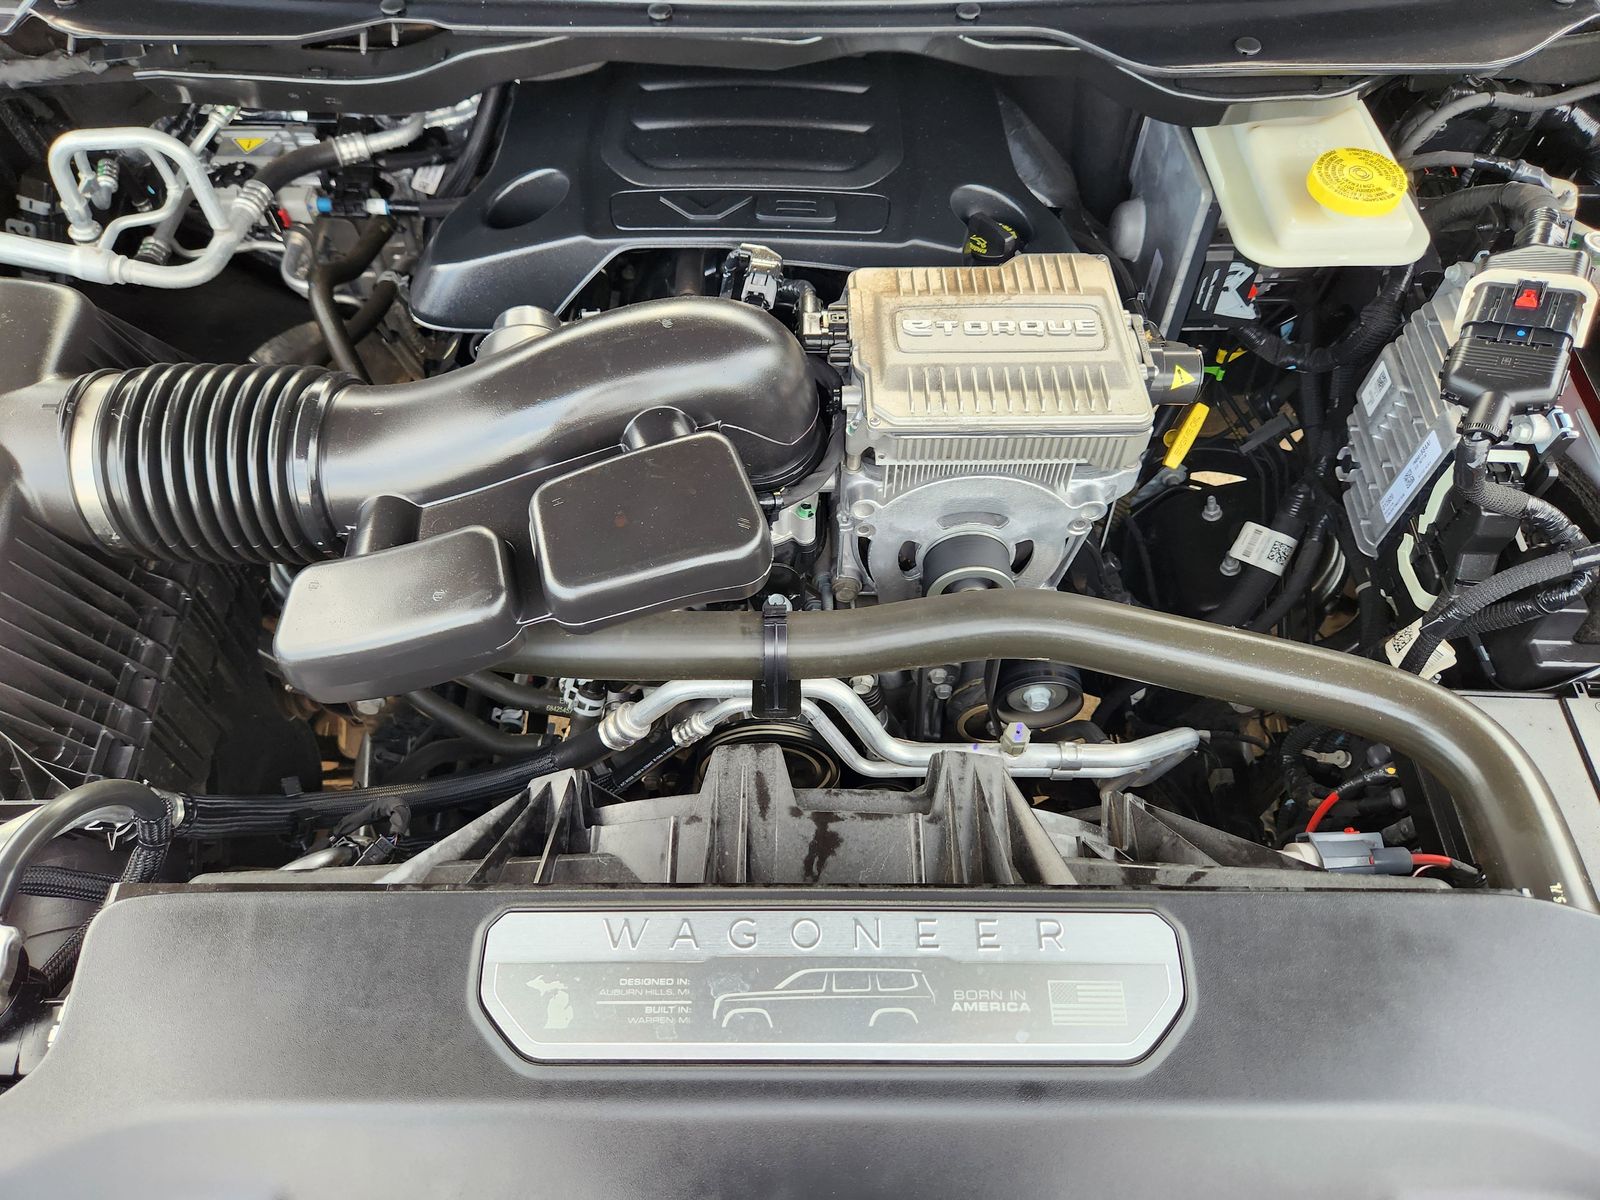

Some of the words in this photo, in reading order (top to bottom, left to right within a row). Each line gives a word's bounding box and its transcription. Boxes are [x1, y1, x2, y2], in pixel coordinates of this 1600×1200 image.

[659, 194, 837, 222] V8
[603, 917, 1066, 950] WAGONEER
[619, 977, 674, 986] DESIGNED
[677, 977, 690, 986] IN:
[599, 988, 643, 996] AUBURN
[677, 988, 690, 996] MI
[953, 989, 1003, 1000] BORN
[1010, 989, 1026, 1000] IN
[645, 1006, 674, 1014] BUILT
[678, 1006, 692, 1014] IN:
[951, 1001, 1031, 1013] AMERICA
[678, 1016, 690, 1024] MI
